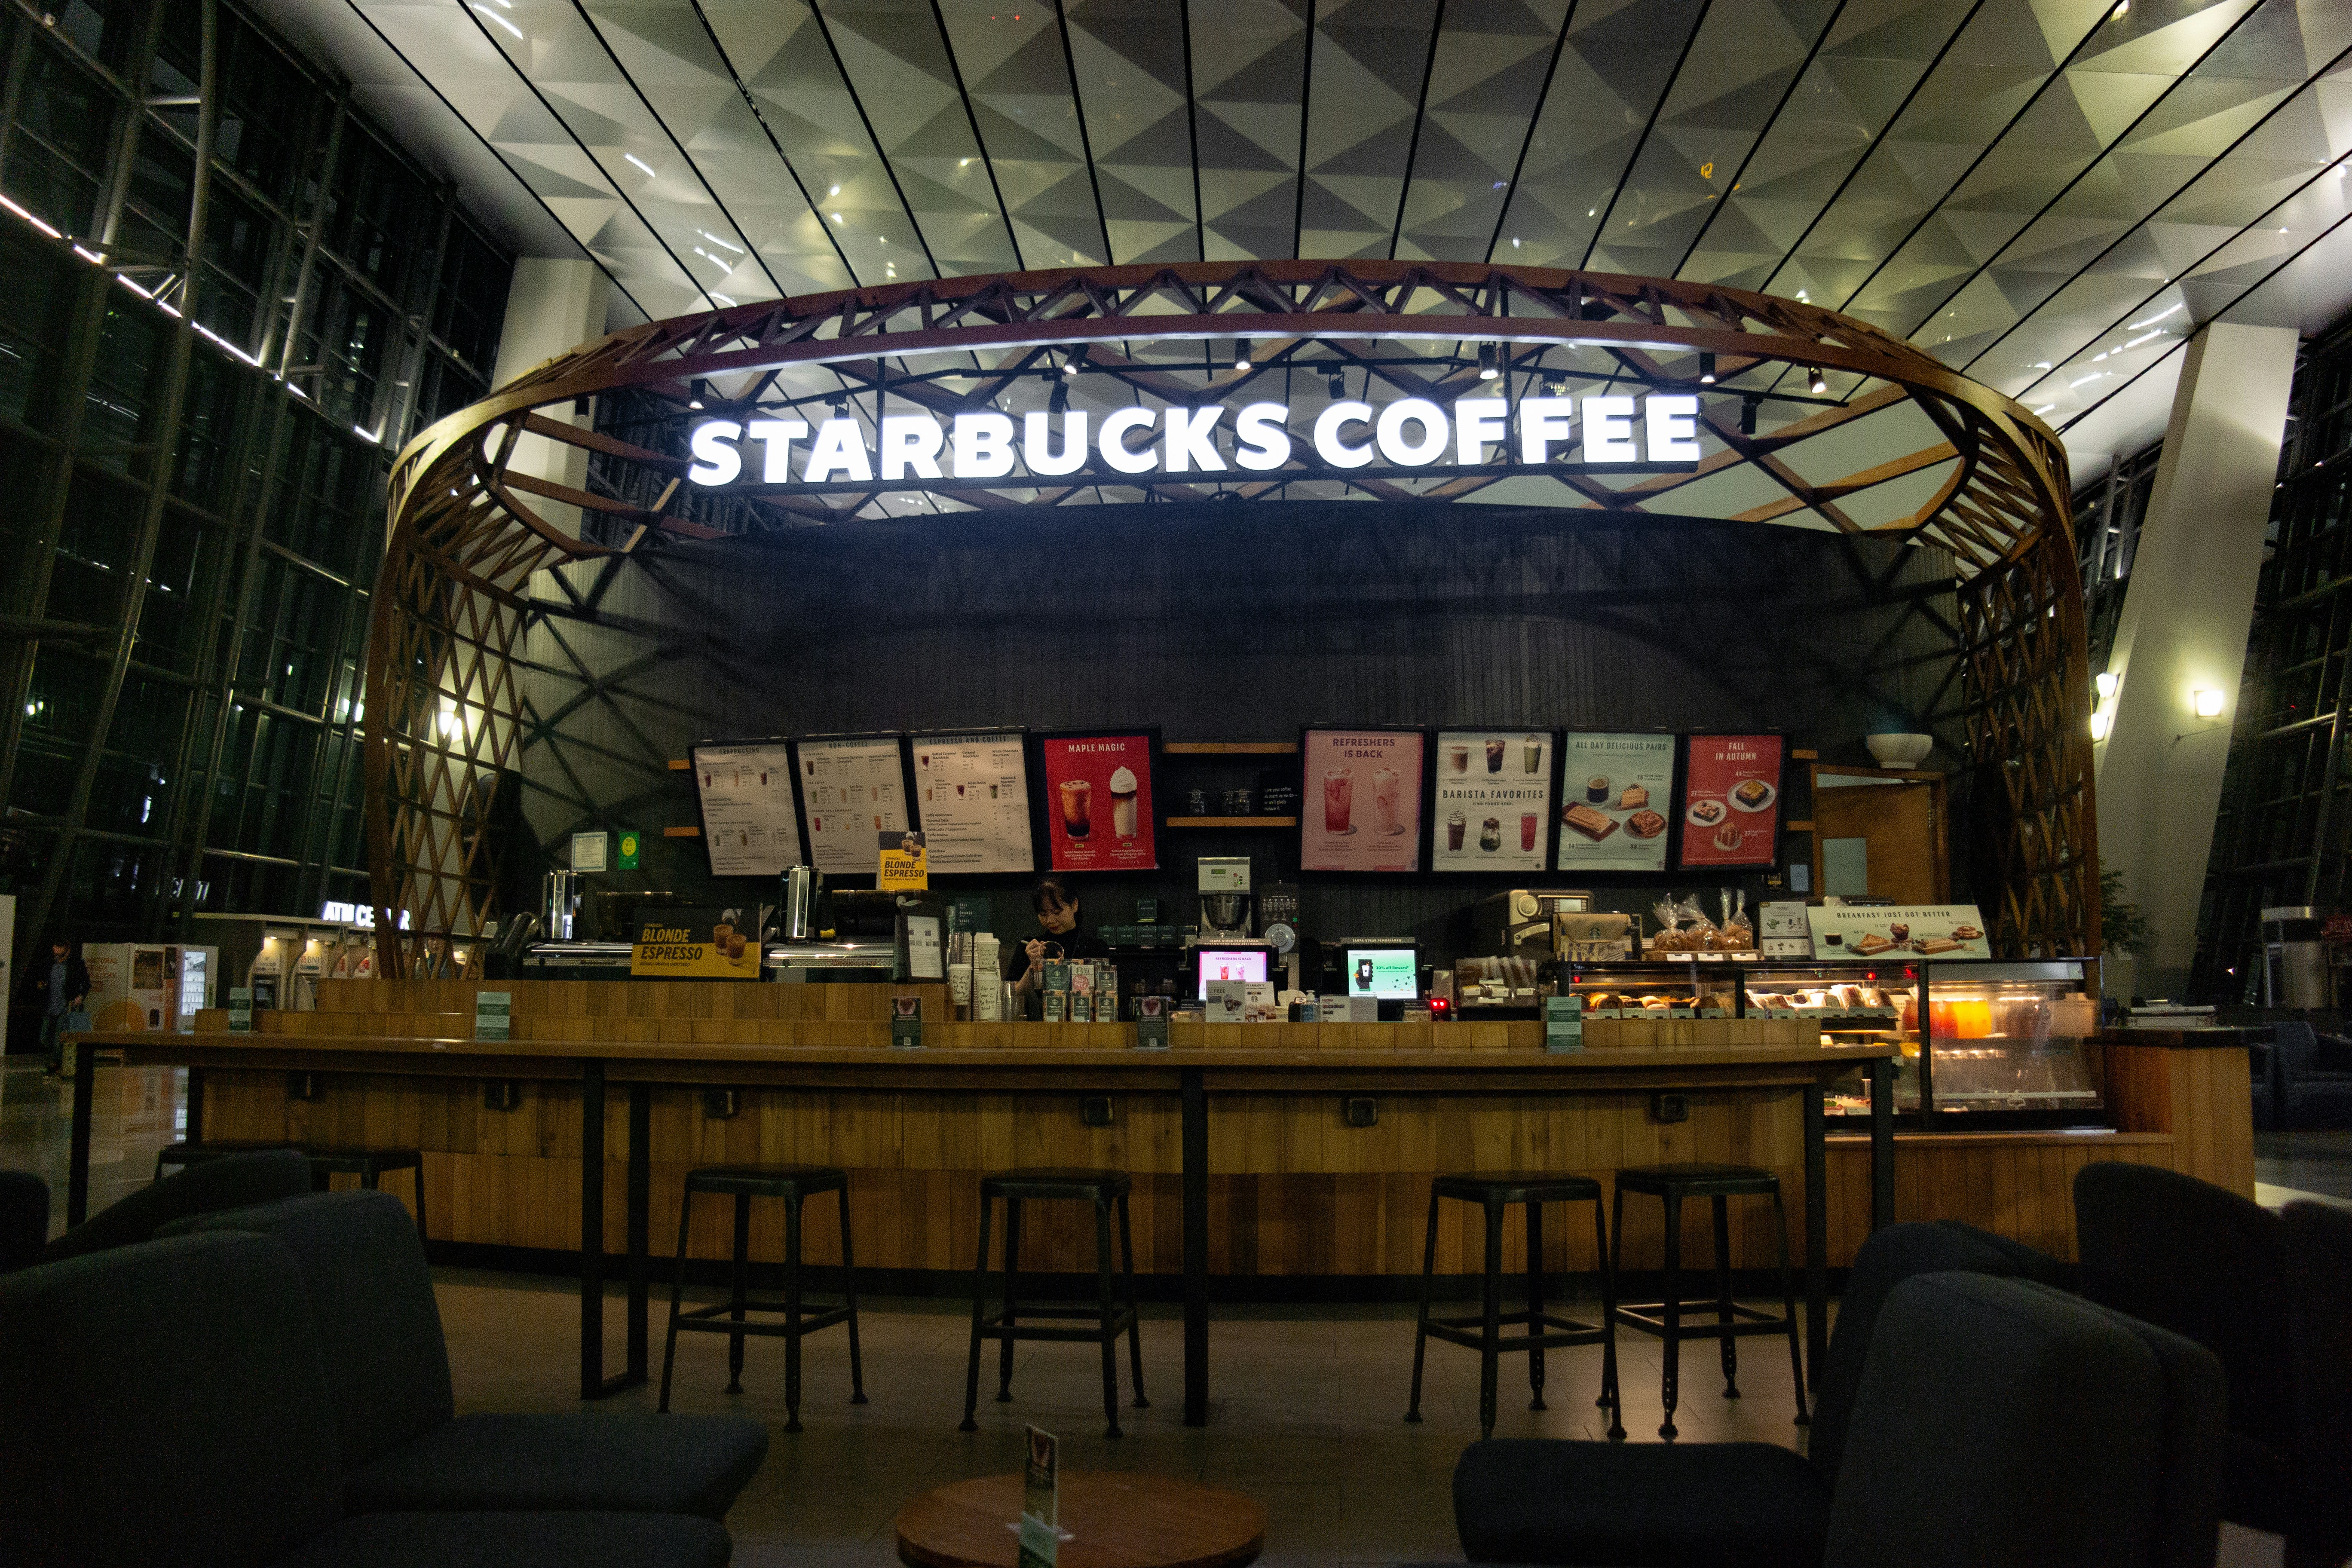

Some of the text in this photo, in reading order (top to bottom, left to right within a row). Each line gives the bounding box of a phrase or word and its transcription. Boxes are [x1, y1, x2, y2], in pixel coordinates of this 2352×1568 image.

[687, 395, 1701, 487] STARBUCKS COFFEE
[1069, 743, 1125, 752] MAPLE MAGIC
[1726, 752, 1756, 760] AUTUMN
[1443, 790, 1544, 799] BARISTA FAVORITES
[323, 901, 410, 930] ATM CER
[641, 928, 691, 943] BLONDE
[641, 946, 703, 960] ESPRESSO
